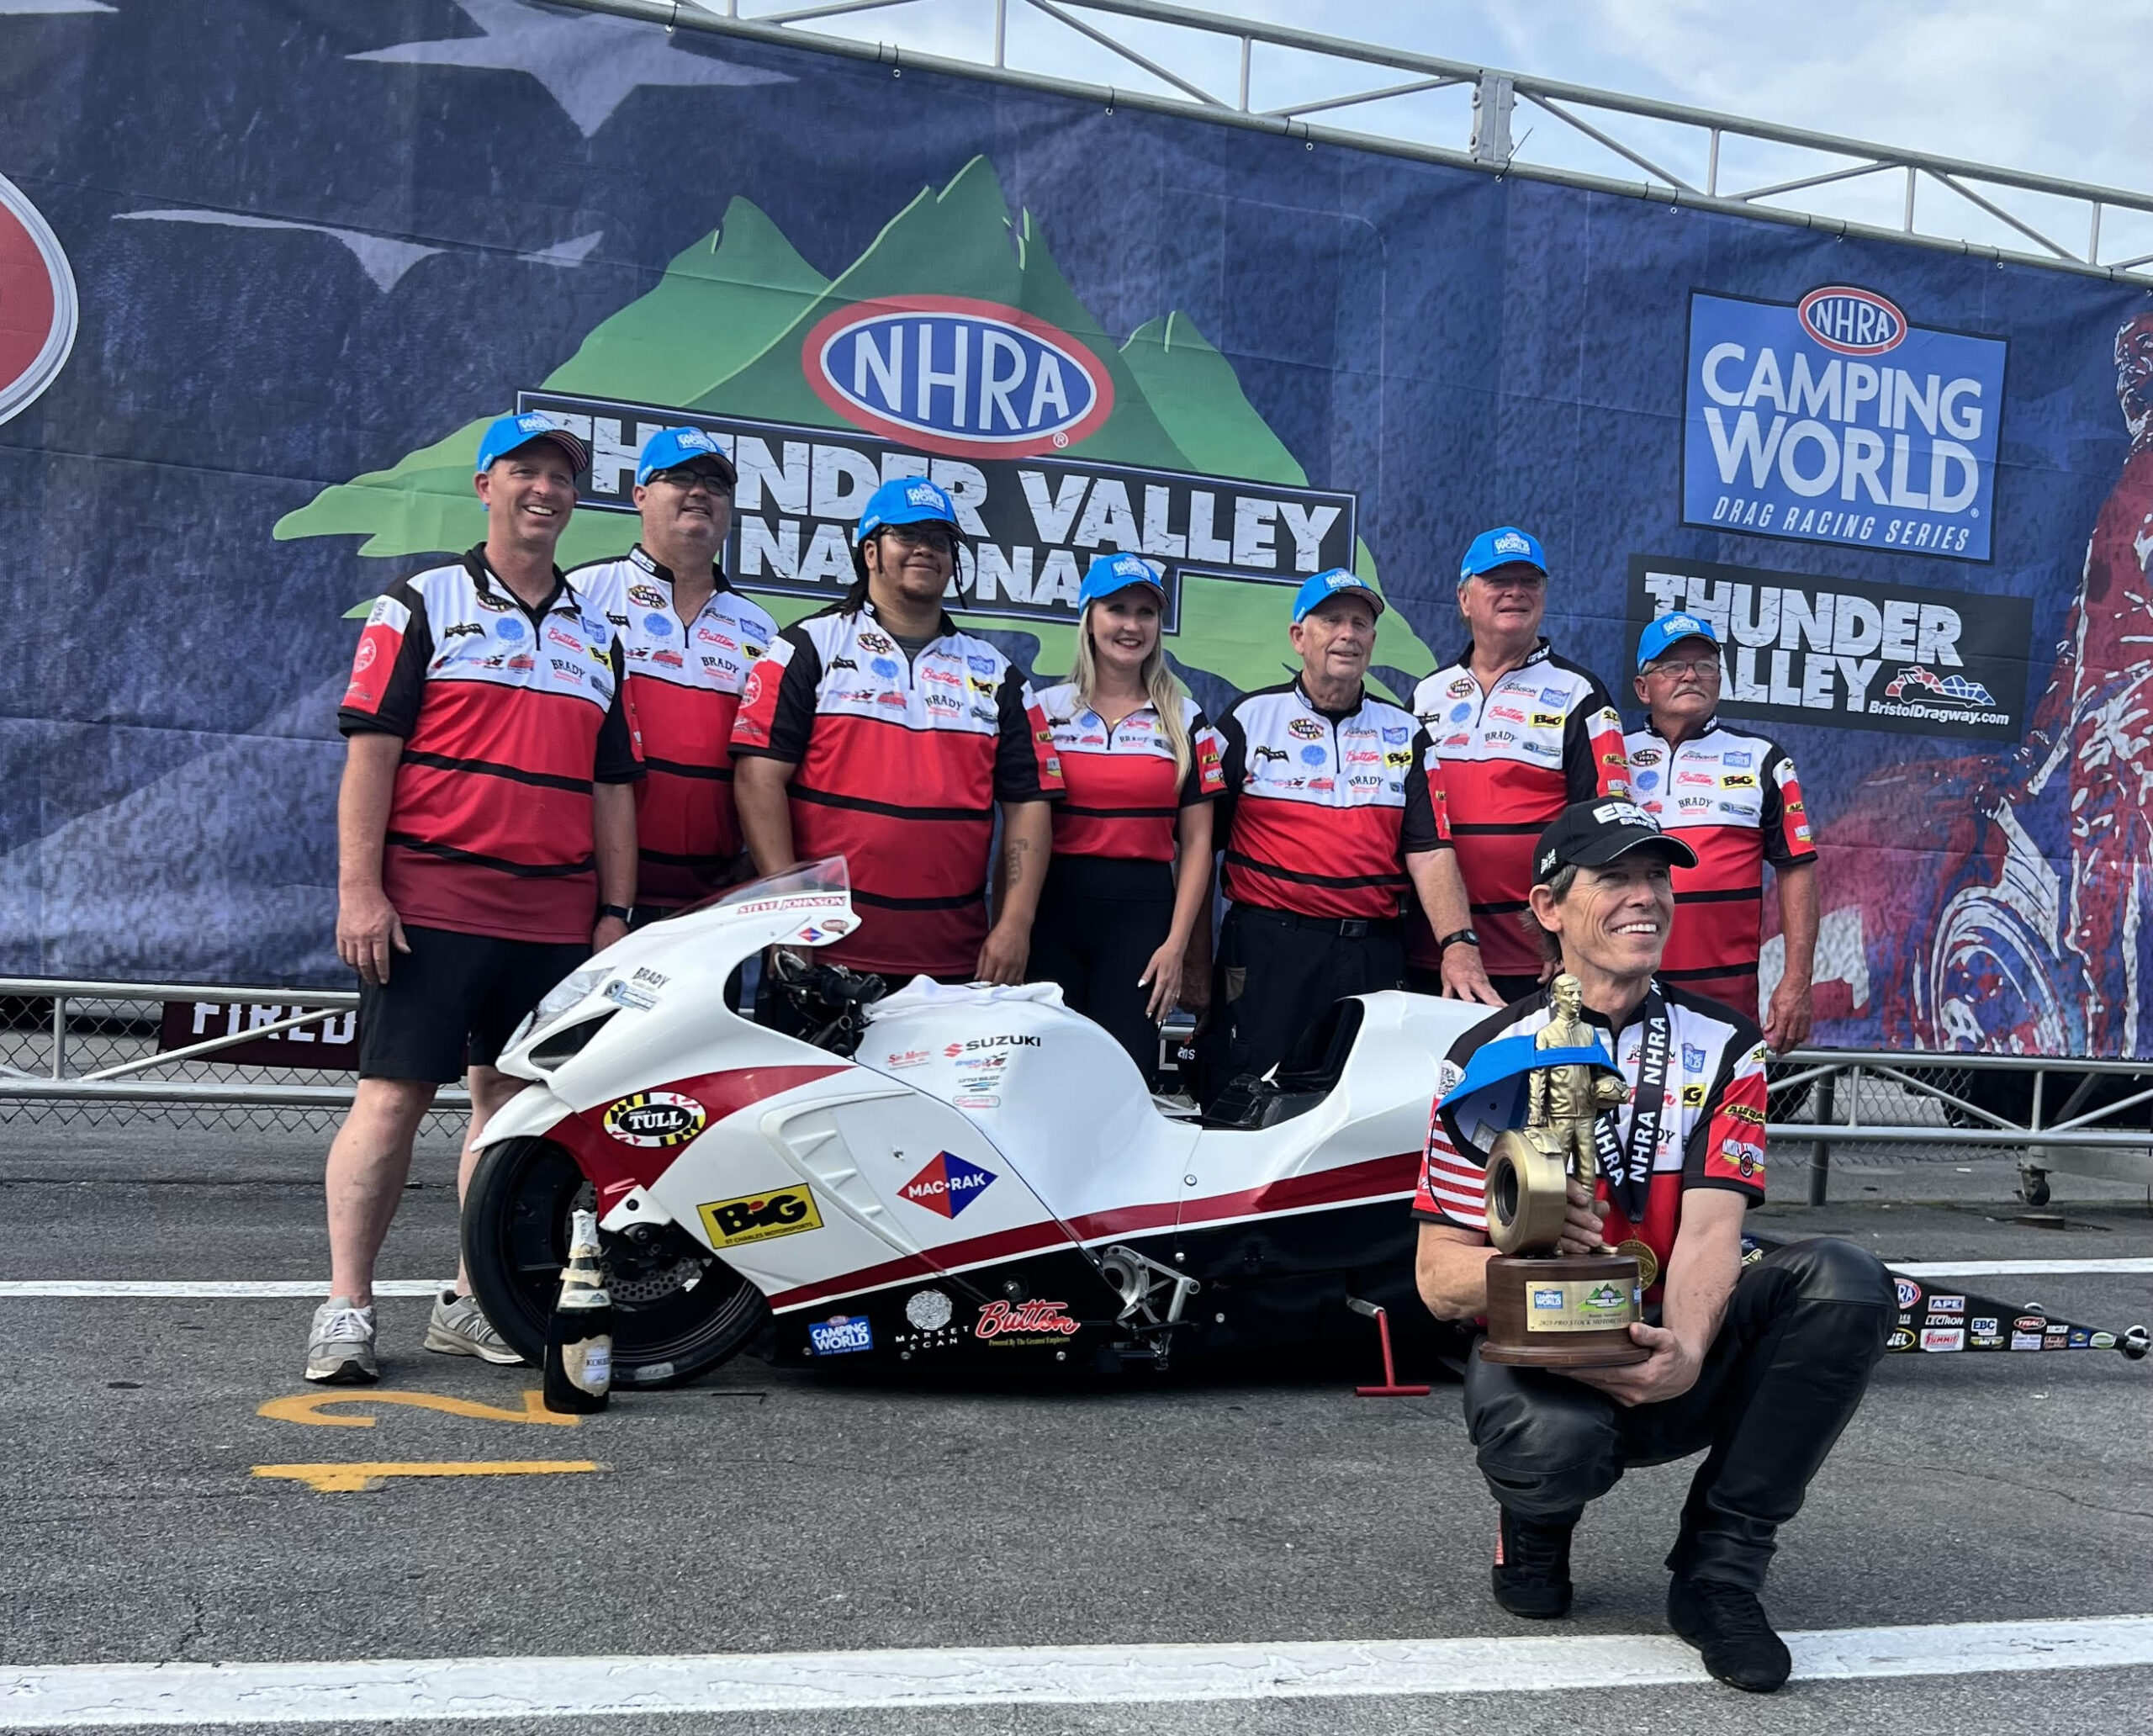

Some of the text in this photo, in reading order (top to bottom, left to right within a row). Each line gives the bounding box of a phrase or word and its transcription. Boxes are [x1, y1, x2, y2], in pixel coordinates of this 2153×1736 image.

[1815, 299, 1891, 345] NHRA
[854, 315, 1071, 431] NHRA
[1701, 341, 1983, 441] CAMPING
[1703, 405, 1980, 514] WORLD
[1017, 468, 1342, 573] VALLEY
[1711, 495, 1971, 553] DRAG RACING SERIES
[550, 659, 586, 679] BRADY
[701, 656, 741, 674] BRADY
[924, 694, 965, 712] BRADY
[1868, 700, 2010, 725] BristolDragway.com
[1484, 730, 1518, 743] BRADY
[1348, 775, 1383, 786] BRADY
[1678, 797, 1714, 808] BRADY
[779, 896, 846, 911] JOHNSON
[632, 966, 671, 989] BRADY
[965, 1035, 1041, 1051] SUZUKI
[1643, 1017, 1665, 1086] NHRA
[628, 1110, 684, 1130] TULL
[1595, 1117, 1626, 1187] NHRA
[1628, 1111, 1656, 1183] NHRA
[1932, 1299, 1961, 1309] APE
[975, 1299, 1081, 1338] Button
[1973, 1320, 1996, 1330] EBC
[812, 1322, 868, 1341] CAMPING
[895, 1326, 969, 1343] MARKET
[814, 1333, 870, 1352] WORLD
[909, 1337, 958, 1351] SCAN
